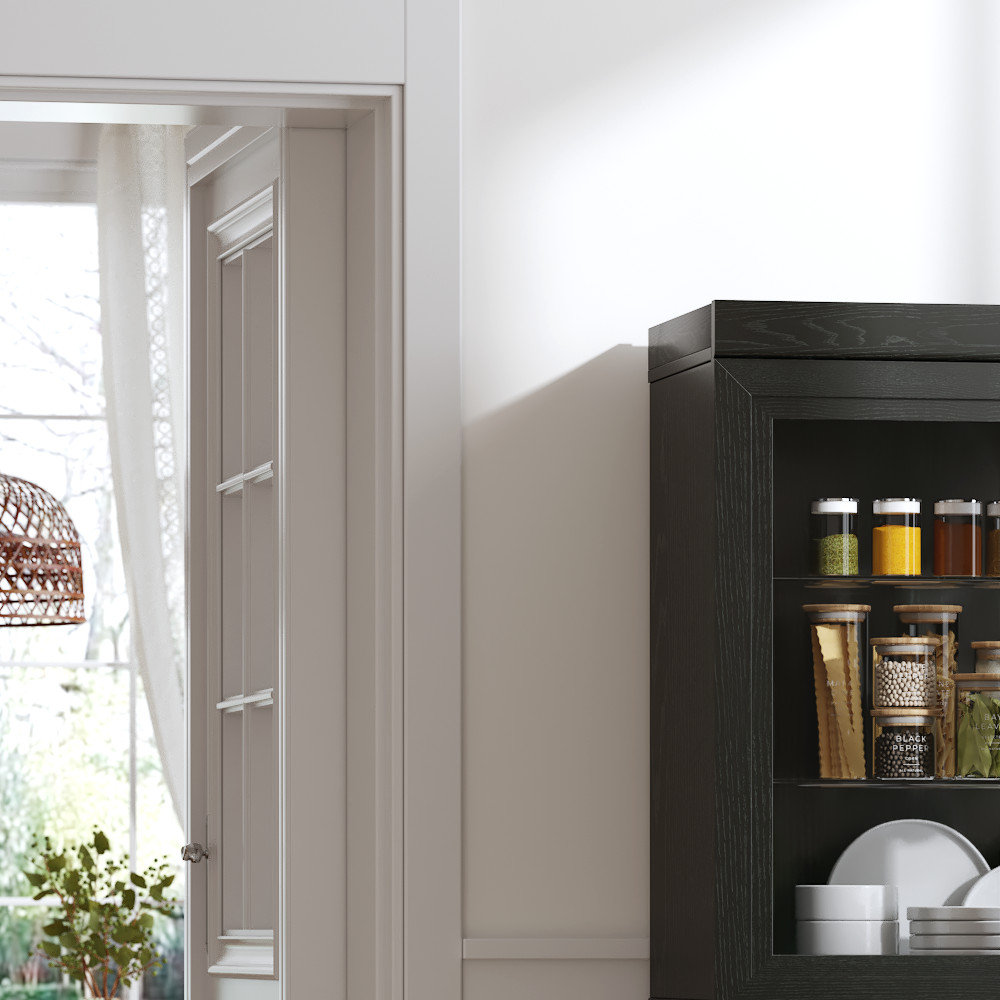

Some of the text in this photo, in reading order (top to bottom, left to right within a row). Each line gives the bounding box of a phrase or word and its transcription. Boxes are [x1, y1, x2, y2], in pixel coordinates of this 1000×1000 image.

[975, 722, 1000, 730] LEAV
[895, 735, 927, 743] BLACK
[892, 744, 929, 752] PEPPER
